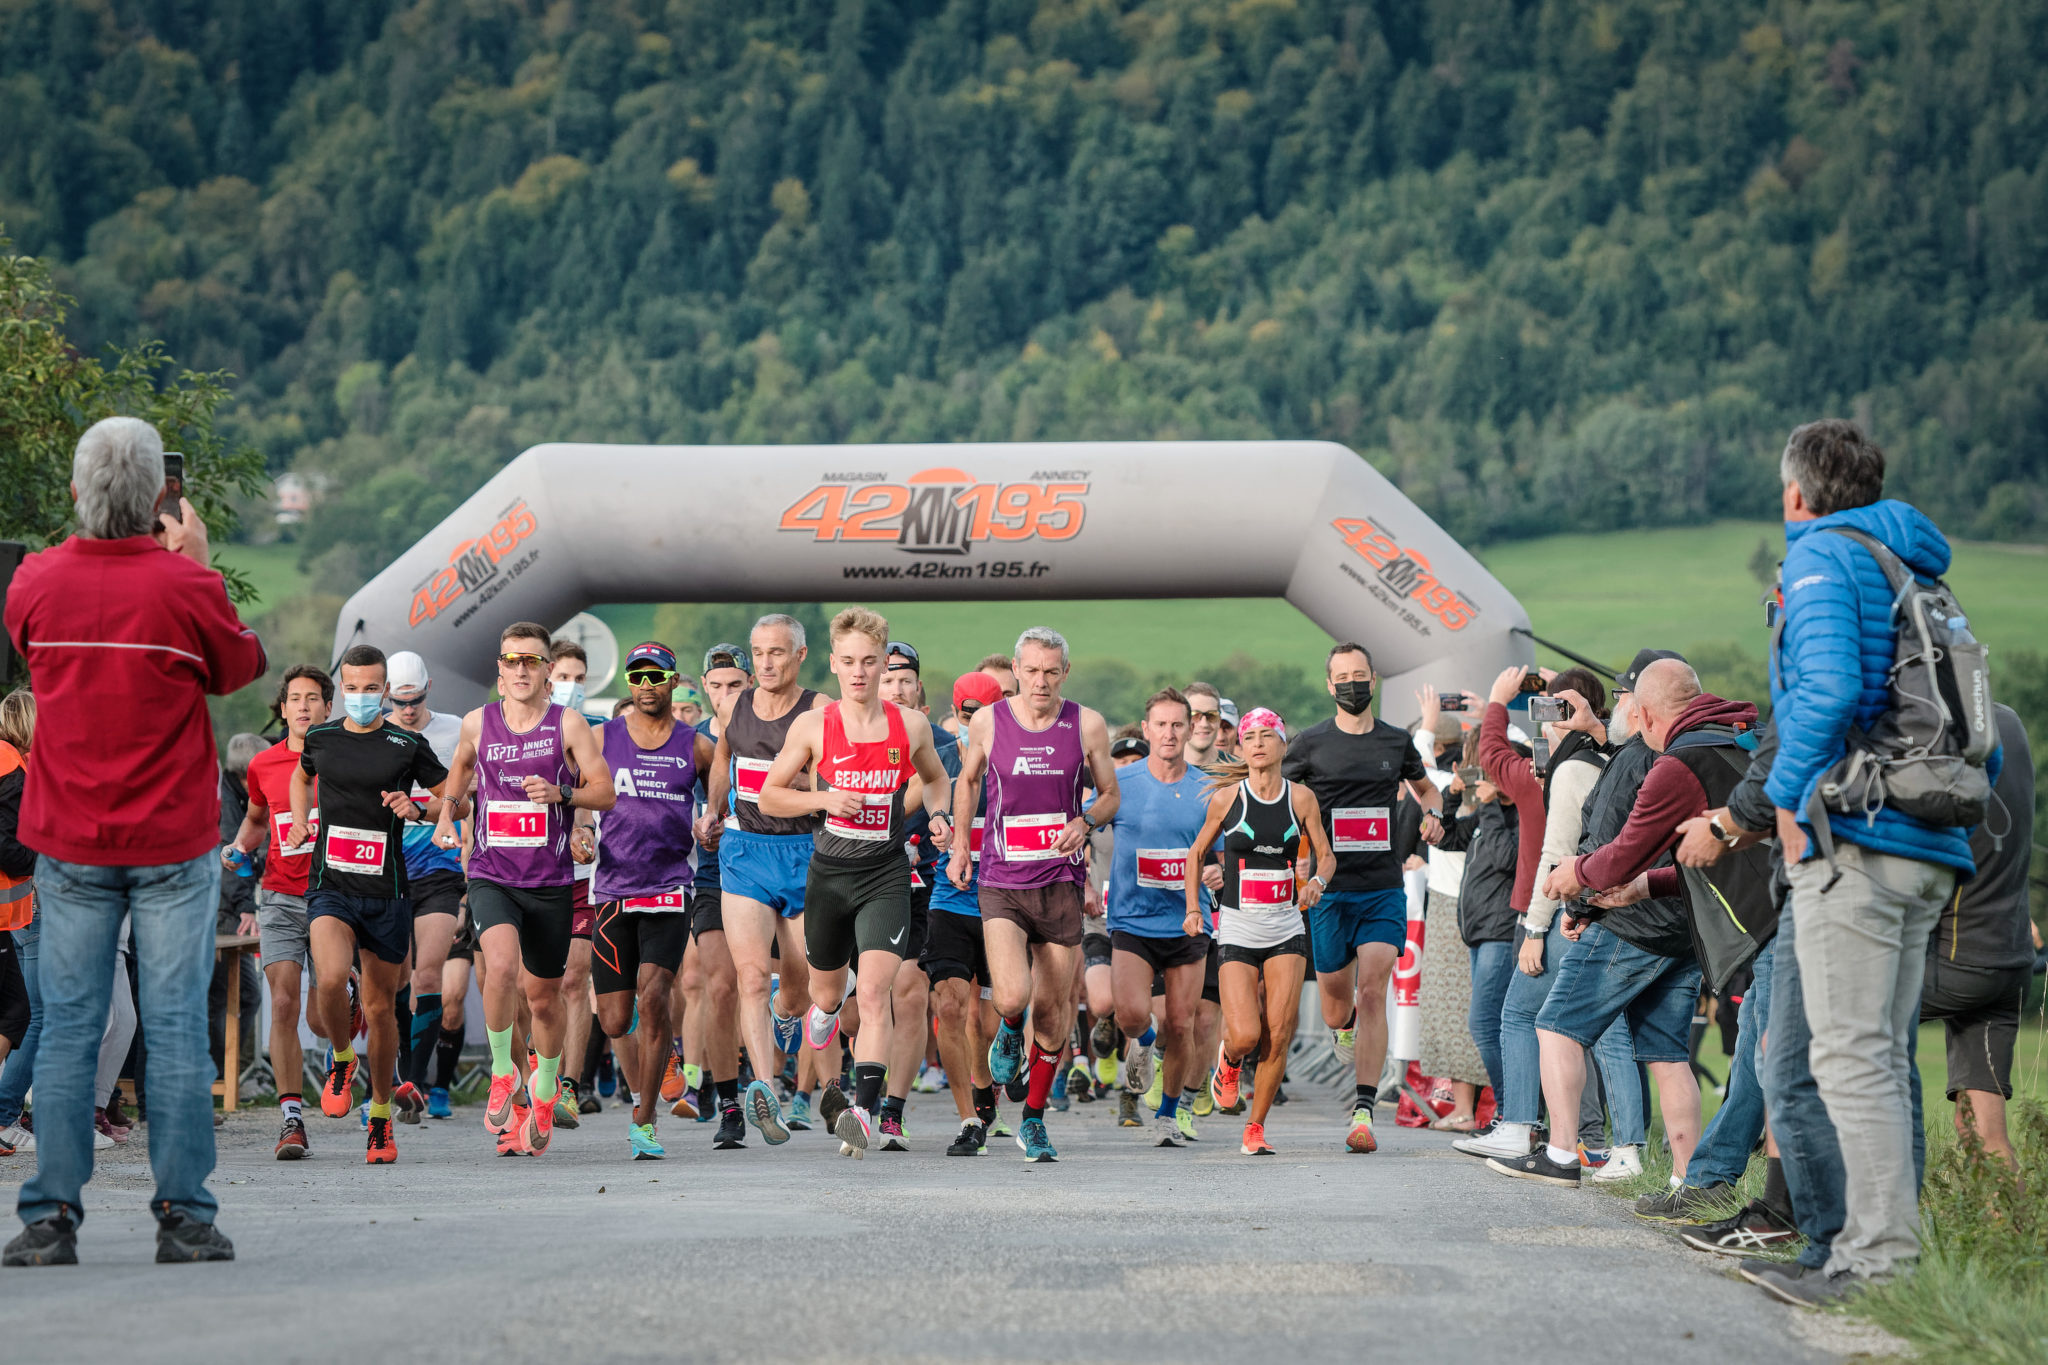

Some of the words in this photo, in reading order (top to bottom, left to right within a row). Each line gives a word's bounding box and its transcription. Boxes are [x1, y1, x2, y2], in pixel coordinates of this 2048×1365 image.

[822, 472, 888, 482] MAGASIN
[1029, 470, 1091, 481] ANNECY
[522, 738, 554, 751] ANNECY
[834, 769, 901, 789] GERMANY
[519, 817, 536, 832] 11
[854, 809, 886, 825] 355
[1368, 821, 1378, 836] 4
[354, 844, 375, 860] 20
[1160, 862, 1184, 877] 301
[1272, 884, 1287, 899] 14
[655, 895, 674, 904] 18
